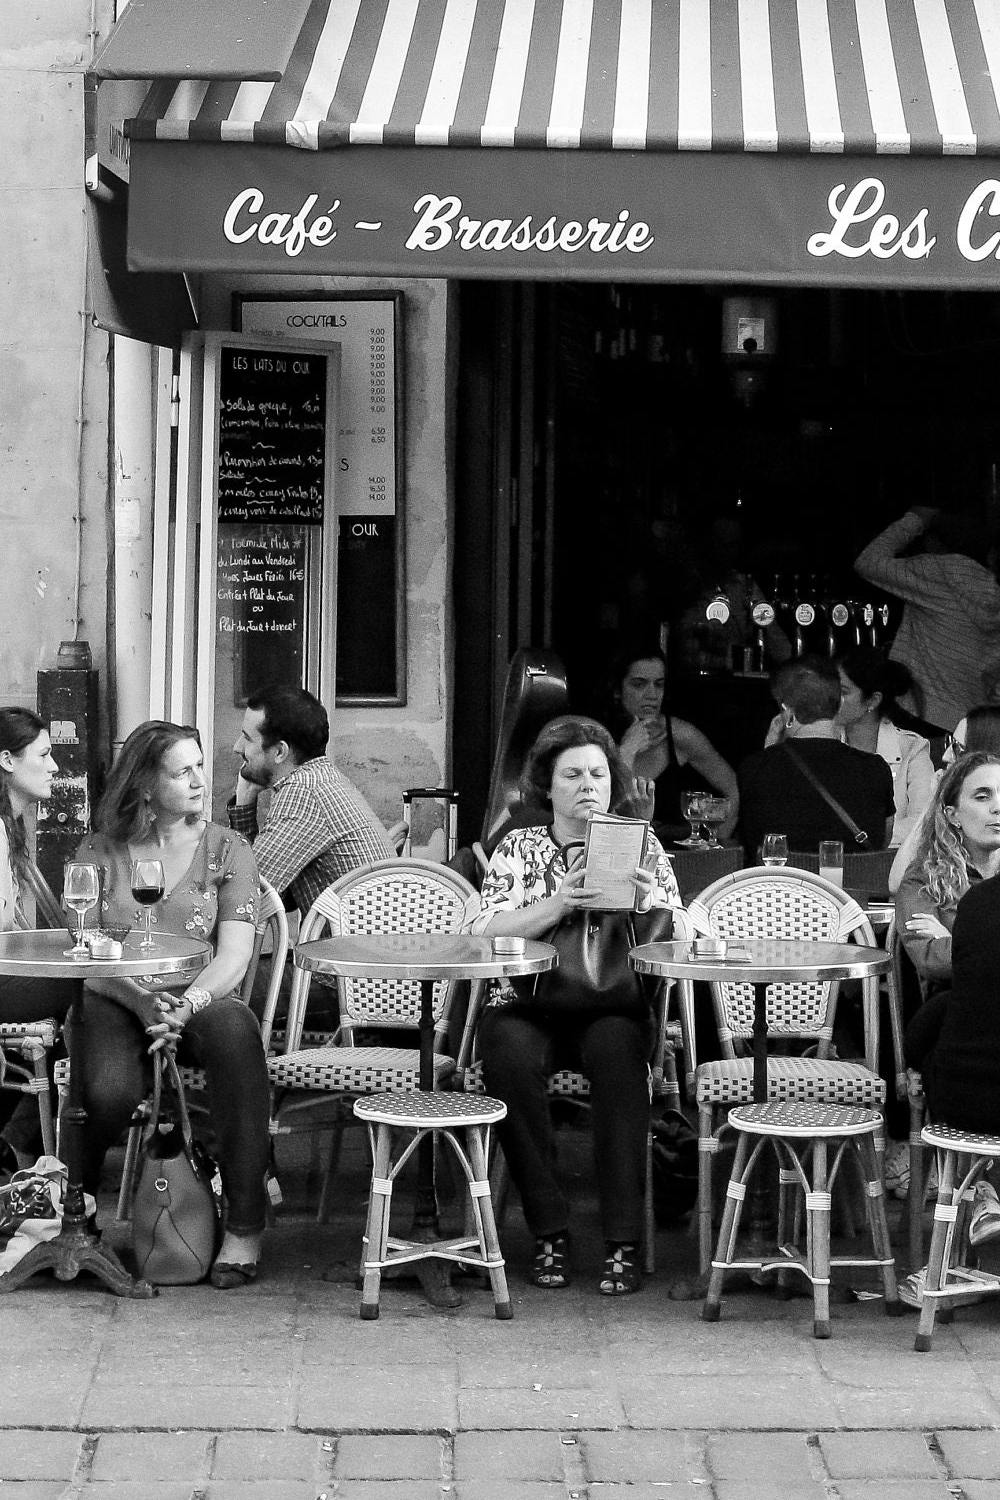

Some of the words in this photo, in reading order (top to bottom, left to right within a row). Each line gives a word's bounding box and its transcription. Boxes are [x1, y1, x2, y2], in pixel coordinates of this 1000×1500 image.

[223, 187, 340, 256] Café
[405, 194, 654, 253] Brasserie
[807, 177, 936, 259] Les
[286, 315, 347, 327] COCKTAILS
